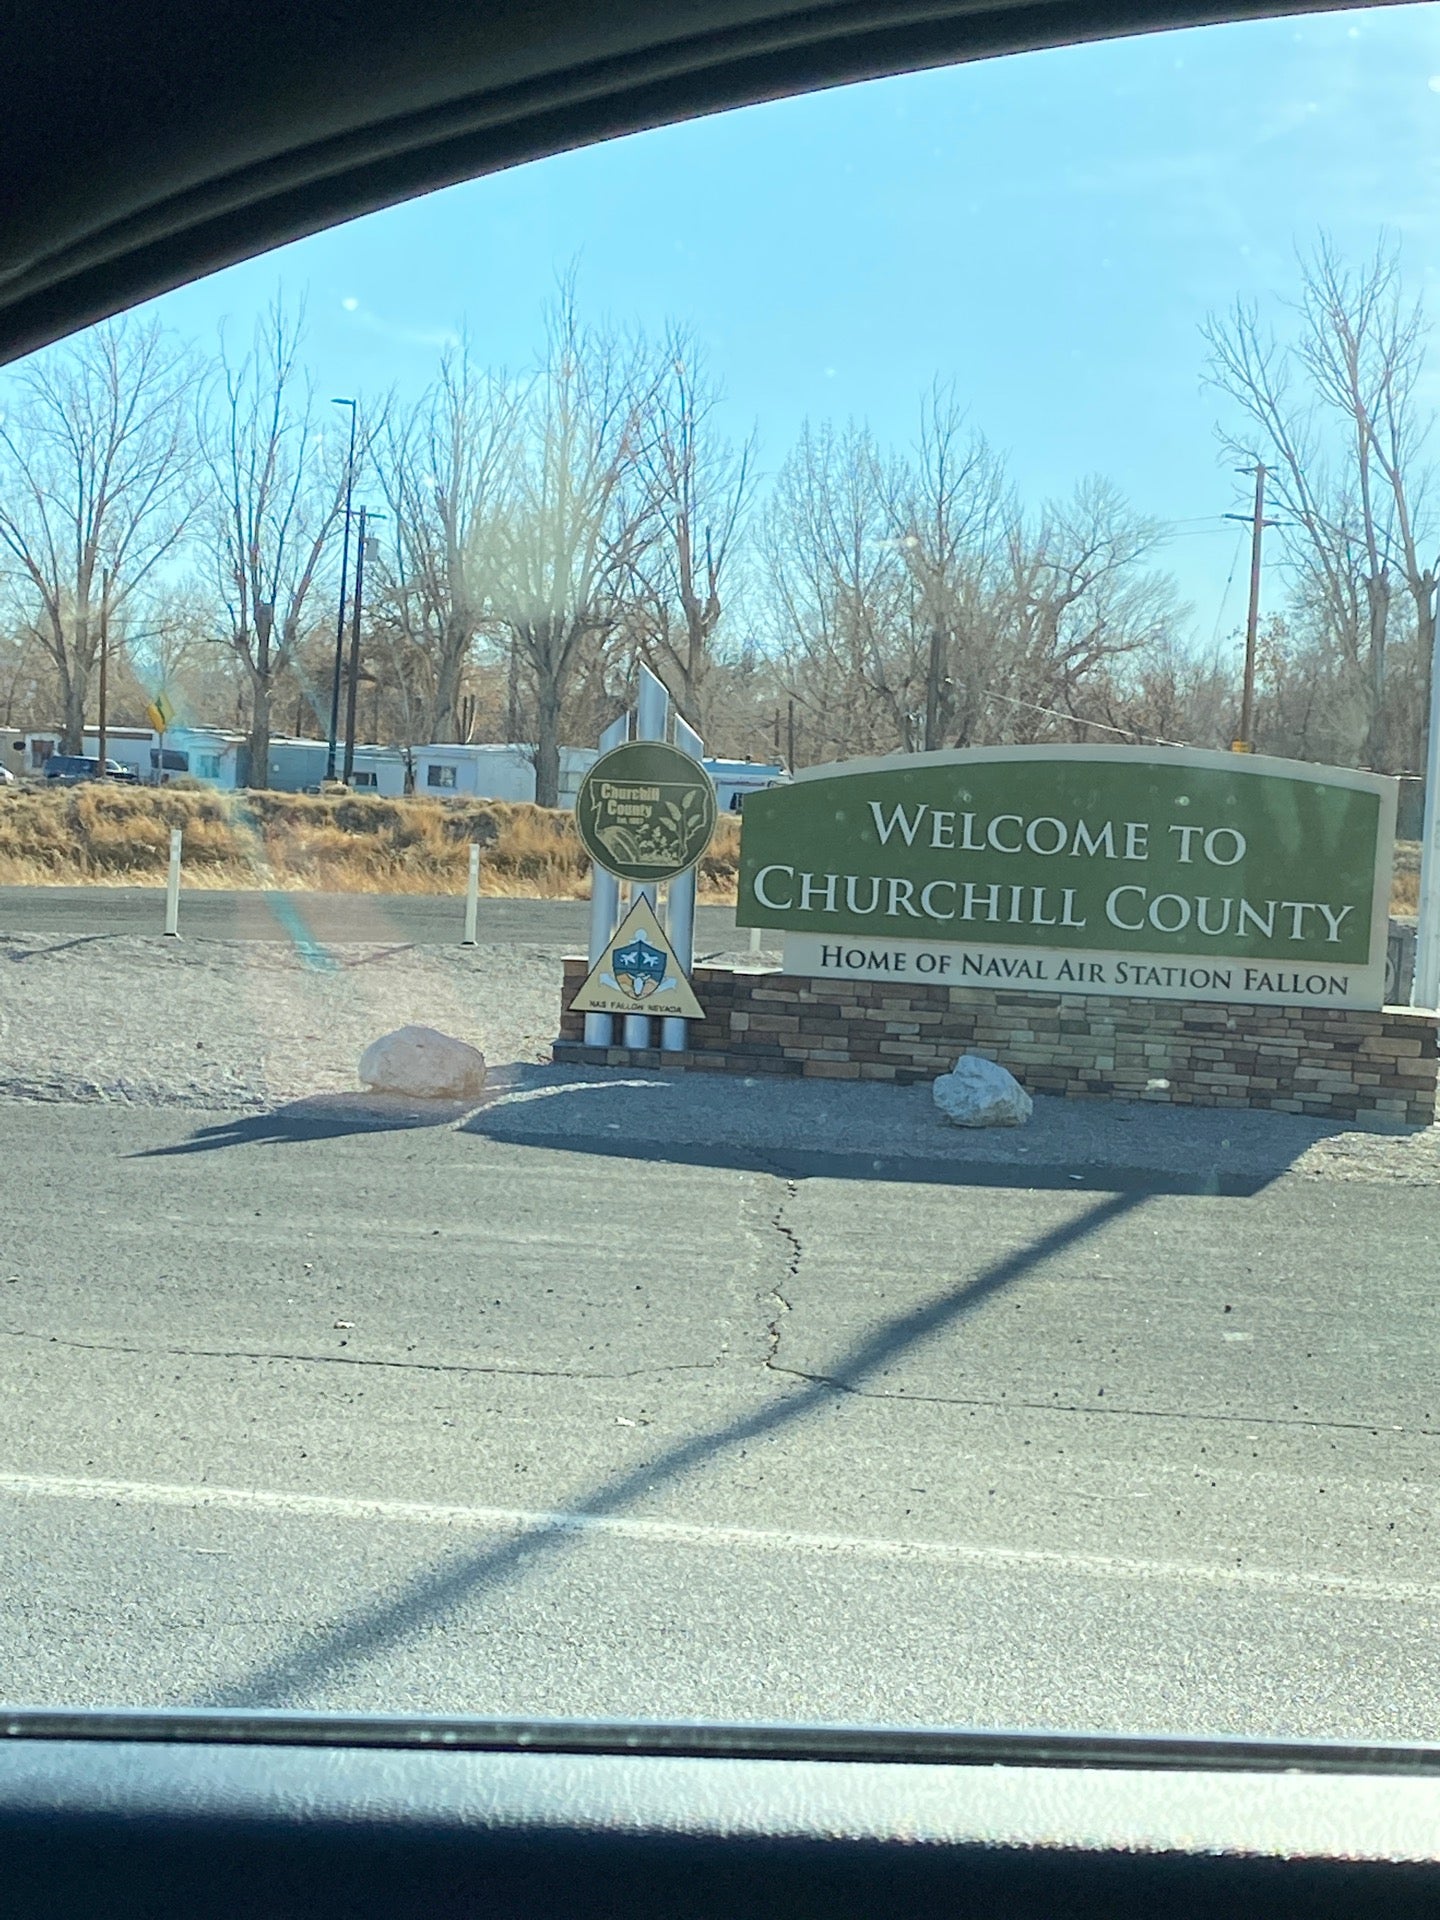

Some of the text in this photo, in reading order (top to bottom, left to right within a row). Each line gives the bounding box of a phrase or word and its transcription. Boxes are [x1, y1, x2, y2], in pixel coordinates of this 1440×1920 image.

[601, 783, 660, 802] Churchill
[607, 799, 653, 818] County
[867, 801, 1247, 867] WELCOME TO
[753, 864, 1355, 944] CHURCHILL COUNTY
[821, 945, 1349, 996] HOME OF NAVAL AIR STATION FALLON
[589, 1000, 682, 1013] NAS FALLON NEVADA
